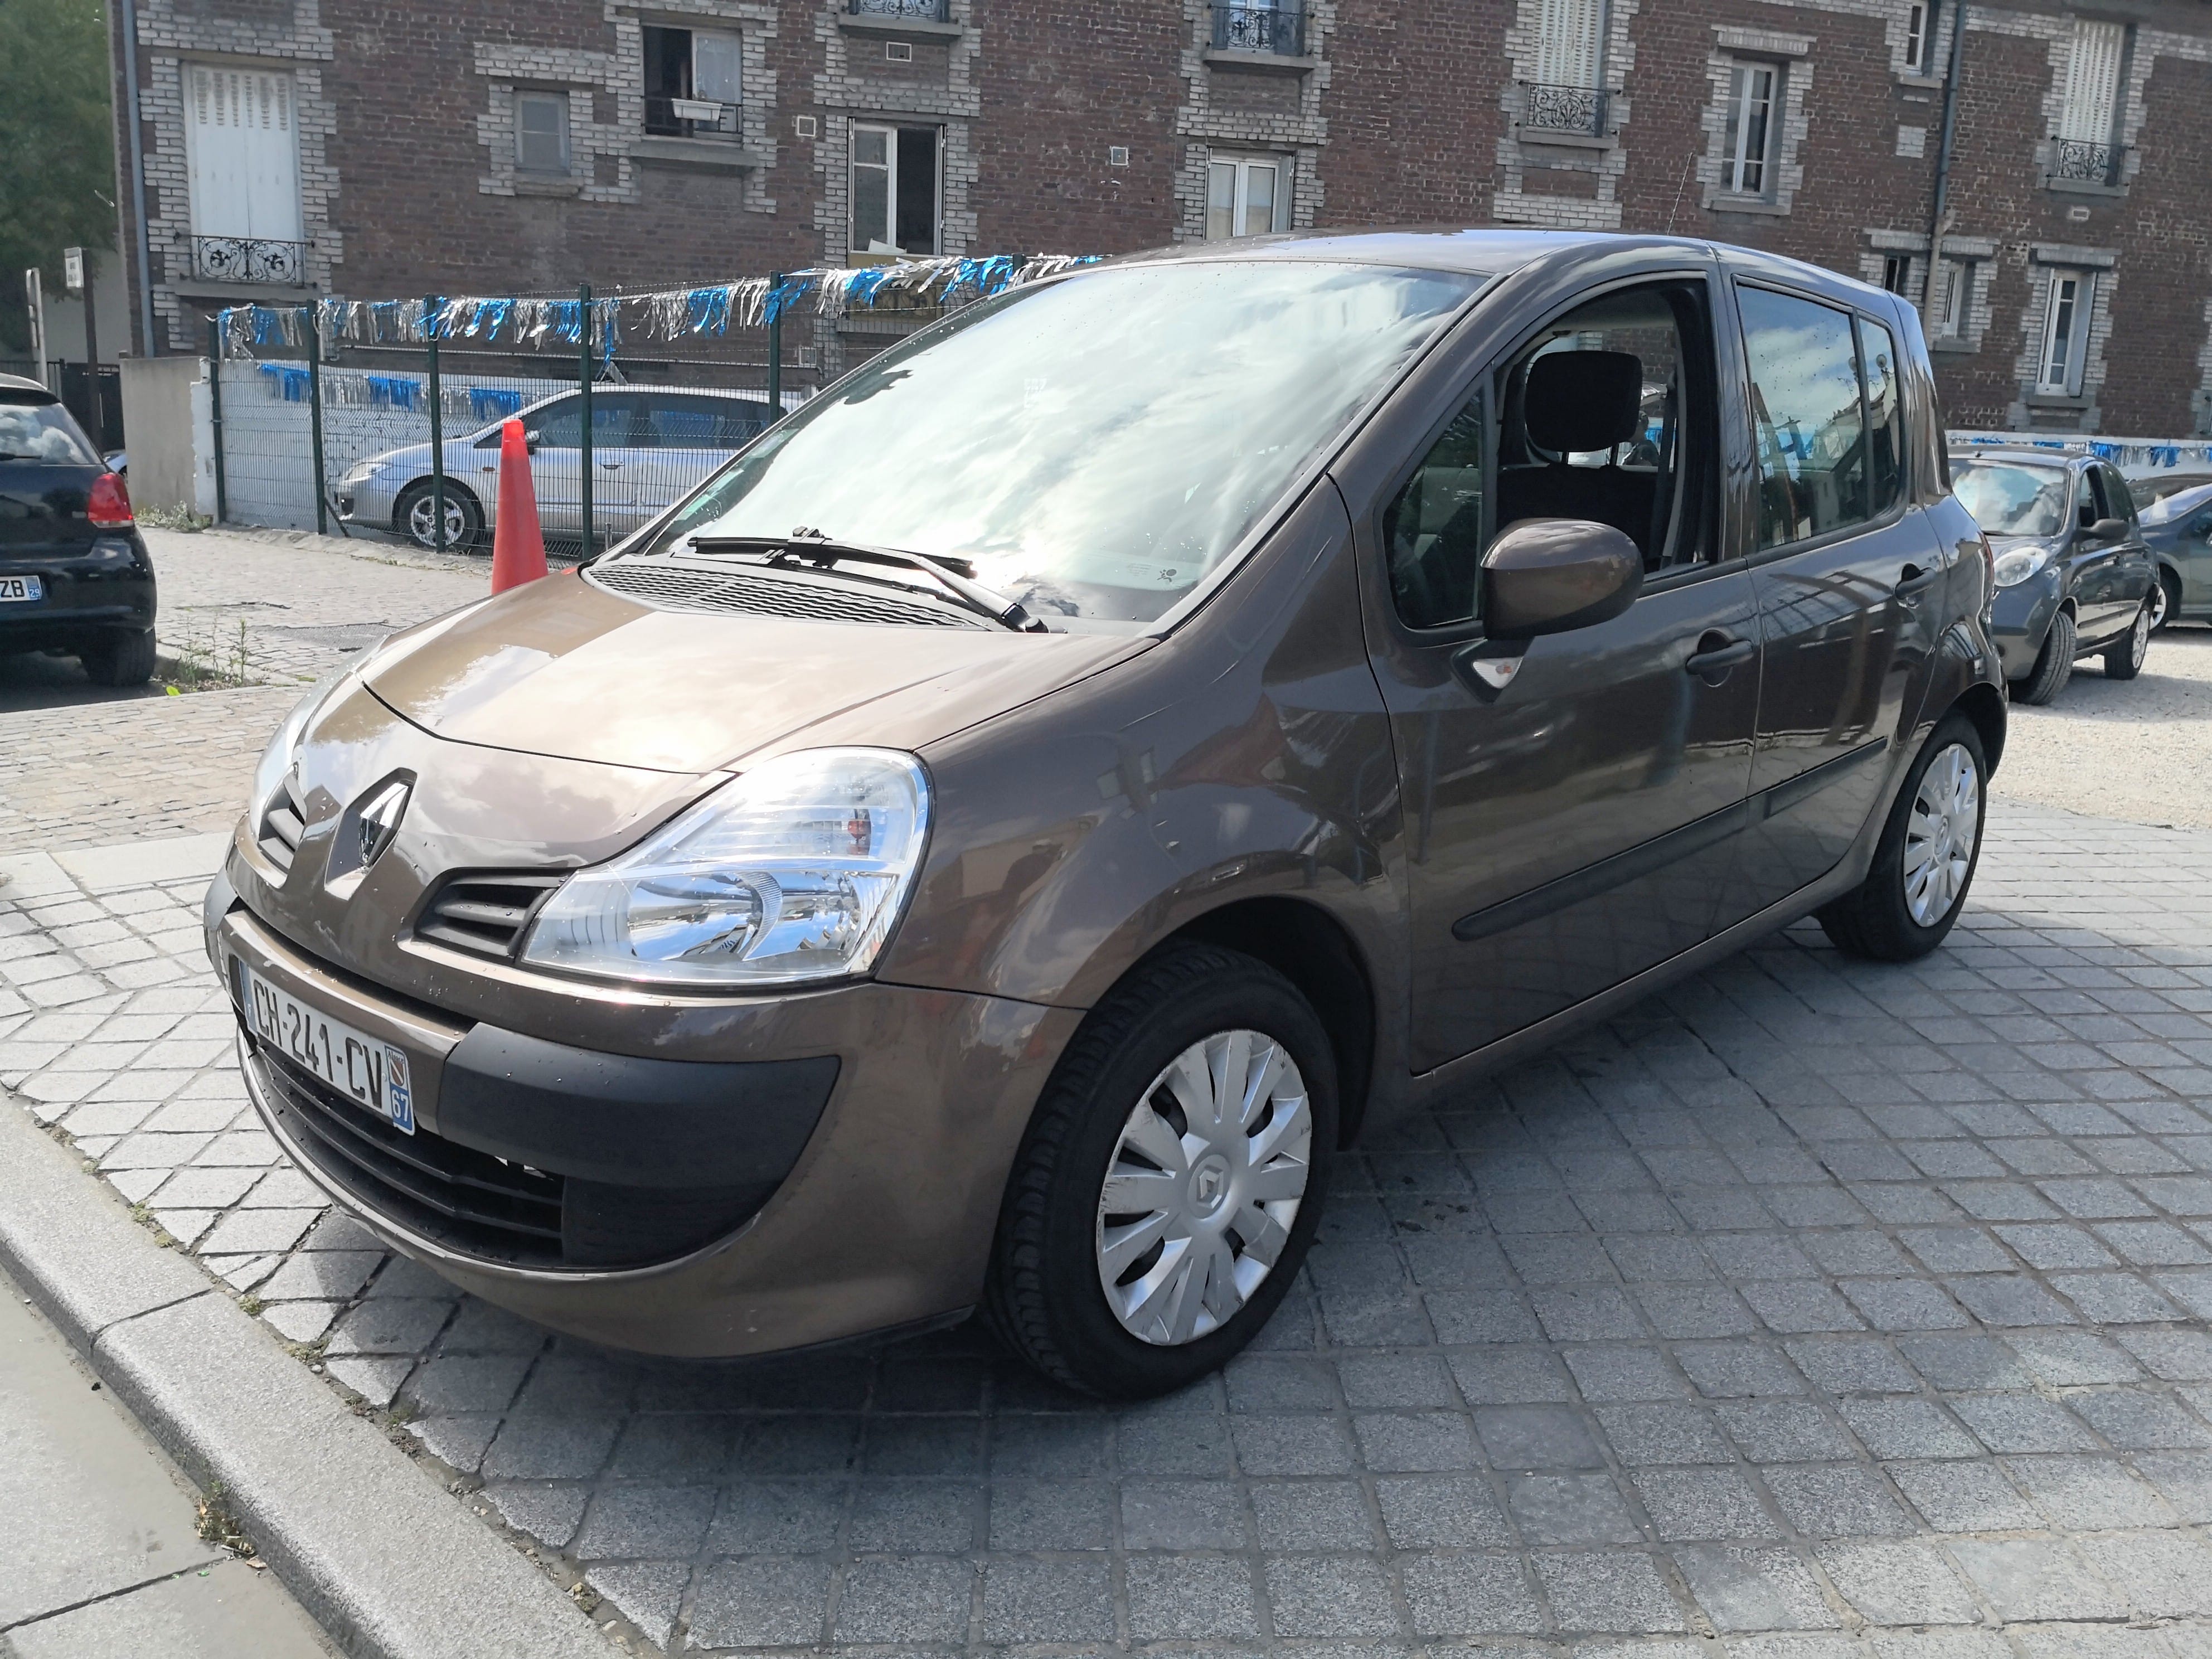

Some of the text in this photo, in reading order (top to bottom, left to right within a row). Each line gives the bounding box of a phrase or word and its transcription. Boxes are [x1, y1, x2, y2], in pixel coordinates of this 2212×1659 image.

[0, 580, 25, 598] ZB
[29, 589, 40, 598] 29
[254, 979, 382, 1109] CH-241-CV
[391, 1089, 409, 1122] 67
